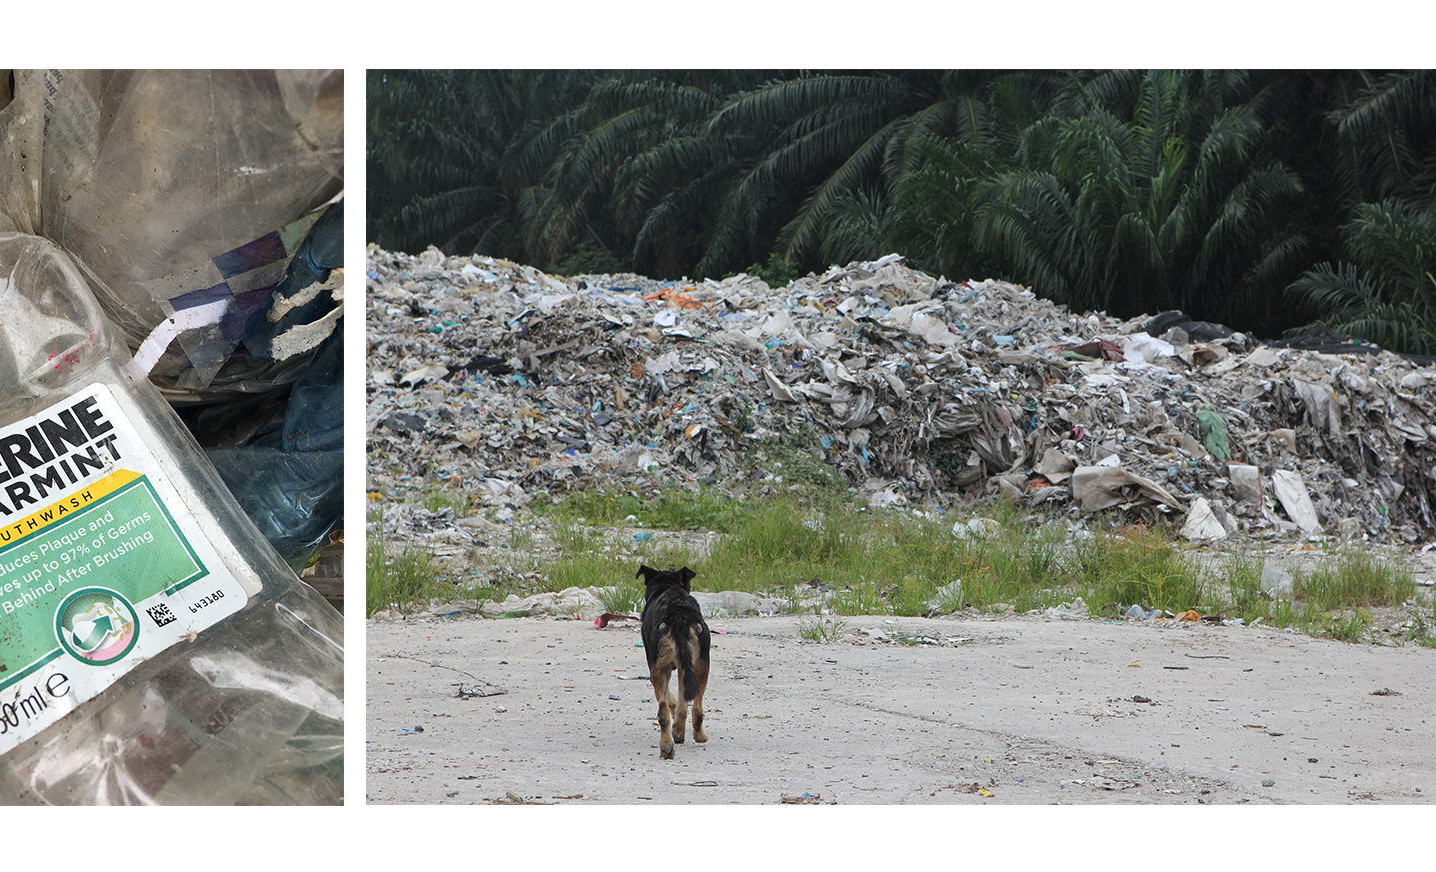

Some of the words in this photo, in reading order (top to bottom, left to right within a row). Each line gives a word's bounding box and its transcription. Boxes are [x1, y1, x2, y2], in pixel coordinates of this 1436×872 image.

[22, 569, 43, 585] up
[43, 560, 60, 573] to
[60, 542, 91, 565] 97%
[92, 533, 106, 549] of
[107, 511, 152, 540] Germs
[38, 526, 88, 556] Plaque
[88, 510, 115, 531] and
[3, 581, 56, 613] Behind
[58, 562, 93, 587] After
[95, 529, 155, 568] Brushing
[20, 686, 48, 719] ml
